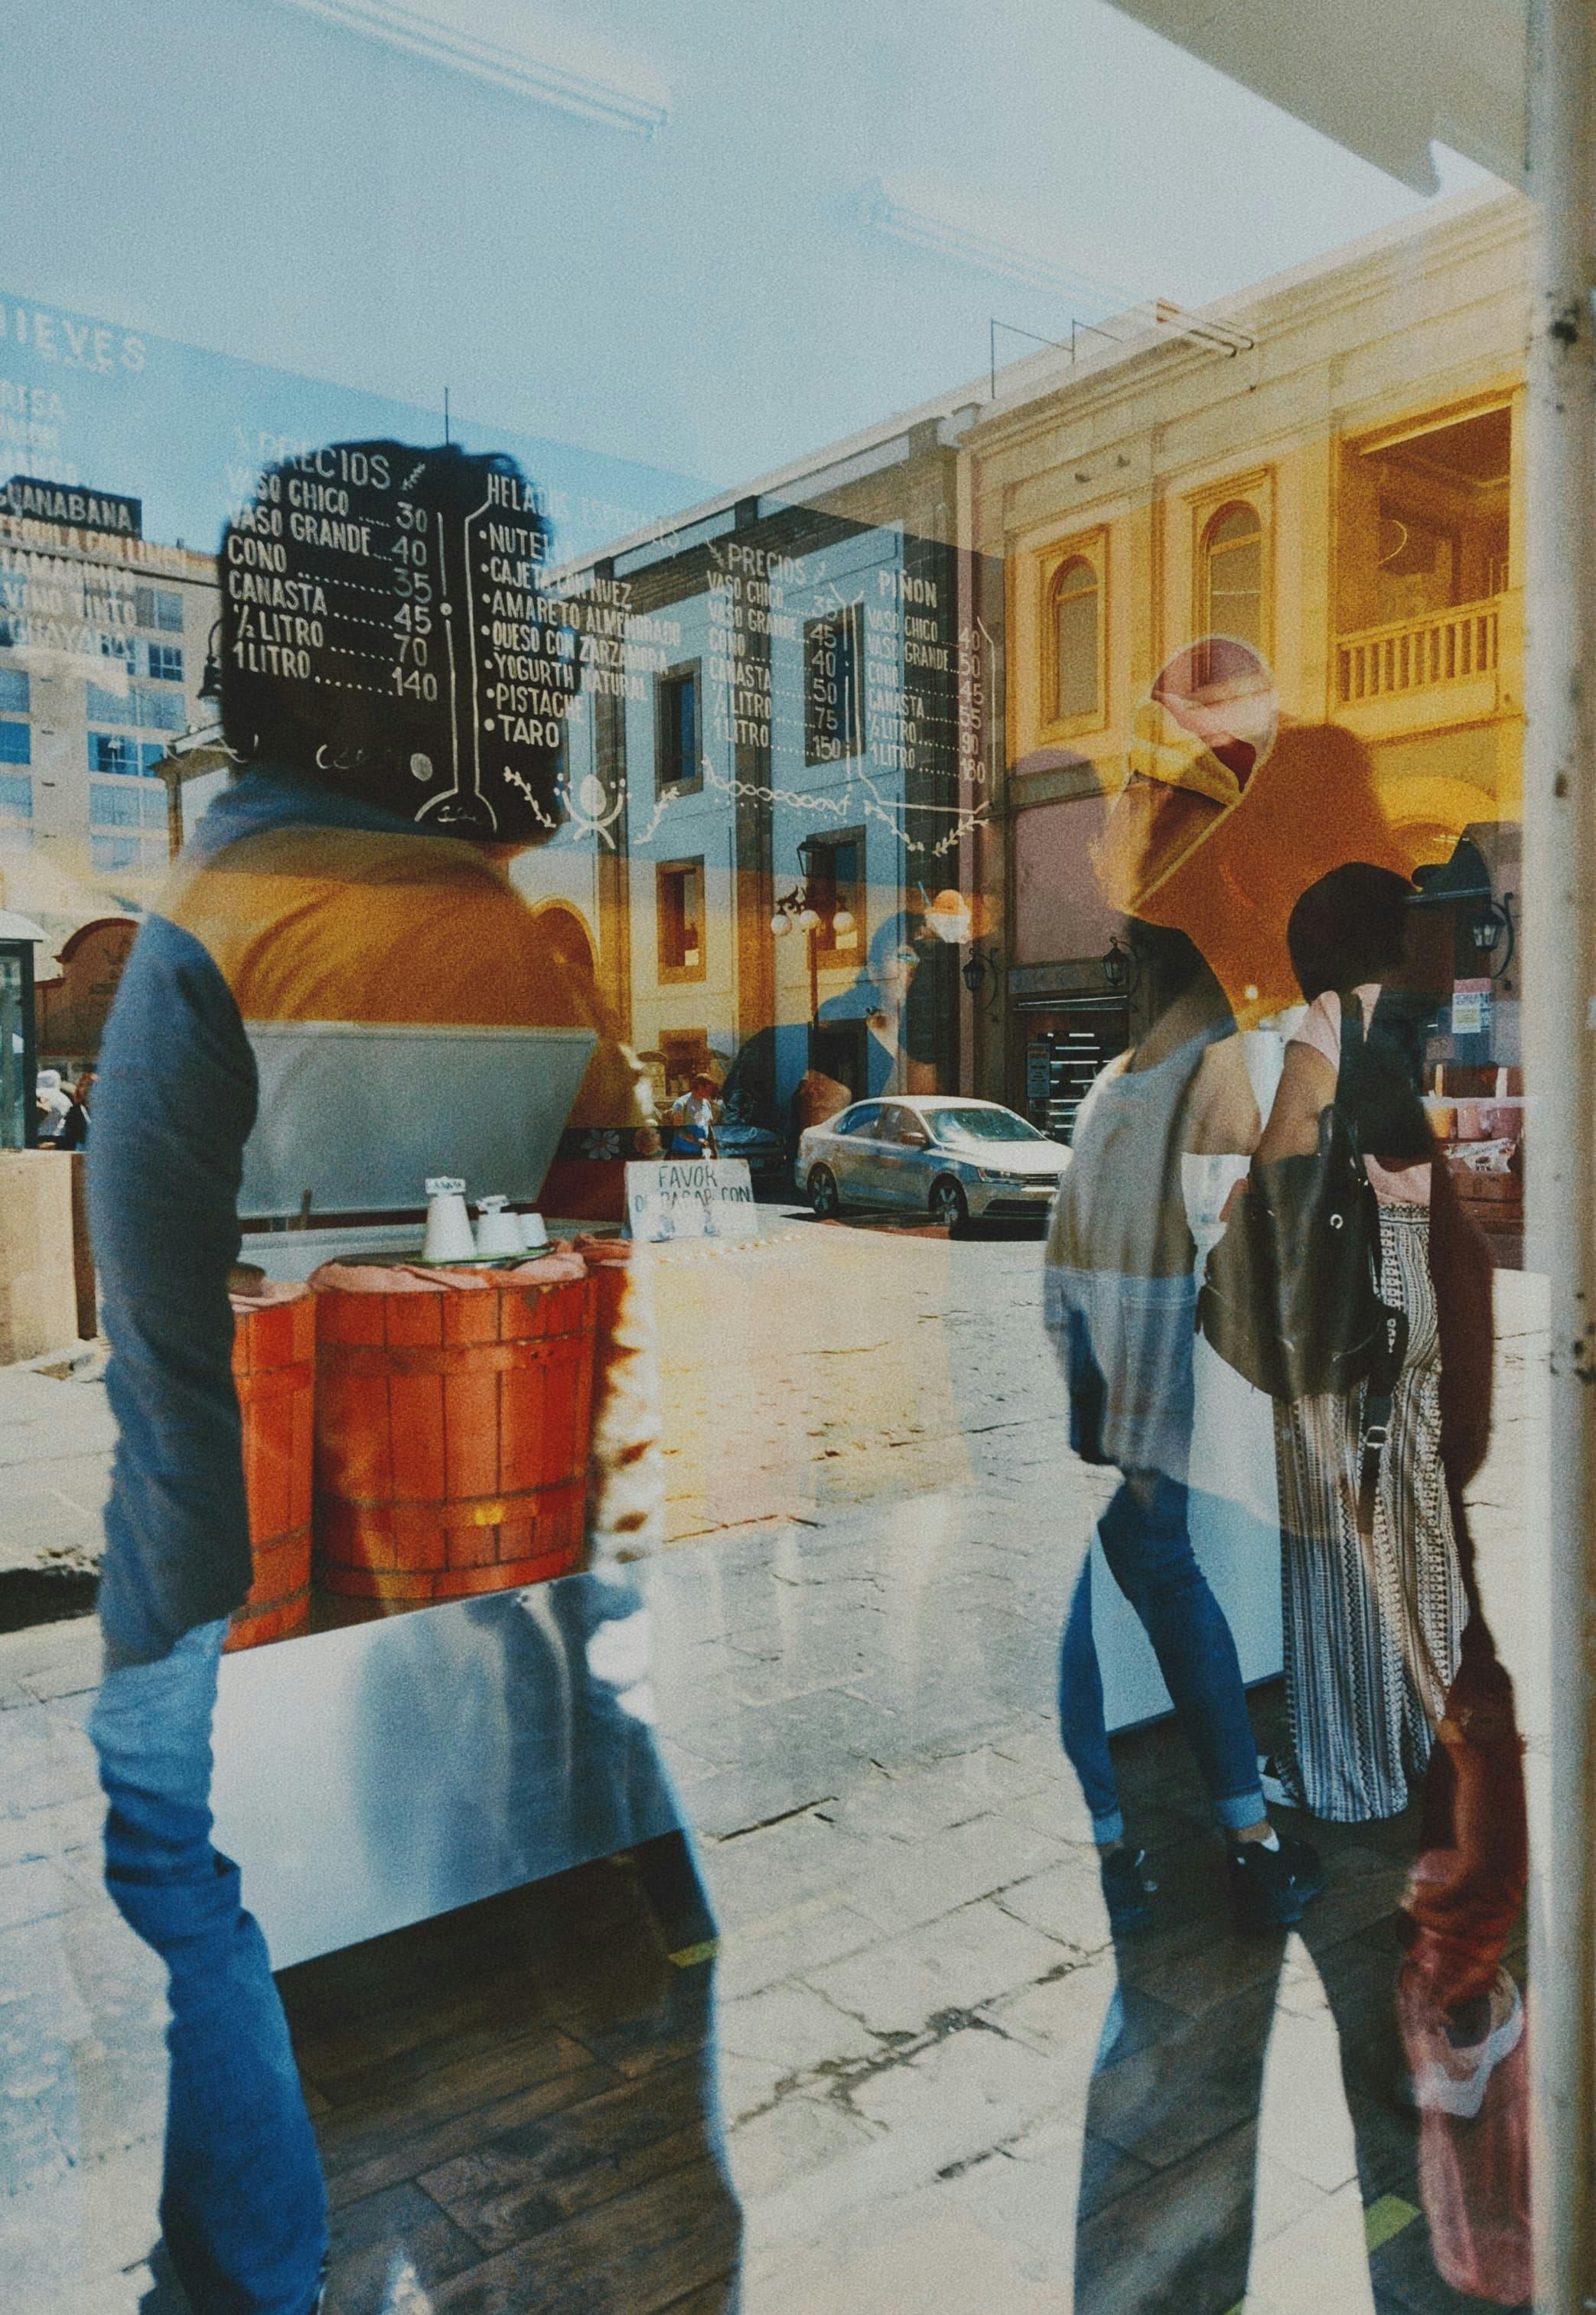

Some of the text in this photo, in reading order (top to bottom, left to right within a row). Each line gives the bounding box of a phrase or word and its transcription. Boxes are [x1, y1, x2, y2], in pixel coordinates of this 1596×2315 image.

[288, 478, 349, 517] CHICO
[396, 501, 428, 533] 30
[228, 499, 427, 566] VASO GRANDE 40
[228, 534, 432, 605] CONO 35
[728, 543, 806, 585] PRECIOS
[229, 569, 432, 634] CANASTA 45
[491, 589, 581, 631] AMARETO
[591, 578, 632, 610] NUEZ
[707, 570, 838, 622] VASO CHICO 35
[259, 610, 324, 648] LITRO
[393, 632, 428, 667] 70
[492, 621, 540, 653] QUESO
[546, 629, 575, 660] CON
[809, 623, 837, 649] 45
[866, 605, 980, 651] VASO CHICO 40
[493, 652, 574, 689] YOGURTH
[709, 656, 838, 705] CANASTA 50
[811, 649, 836, 678] 40
[904, 641, 949, 672] GRANDE
[959, 651, 981, 679] 50
[391, 666, 438, 702] 140
[497, 683, 586, 723] PISTACHE
[959, 680, 985, 706] 45
[729, 688, 772, 720] LITRO
[814, 706, 839, 730] 75
[868, 687, 982, 730] CANASTA 55
[499, 714, 559, 748] TARO
[813, 734, 841, 761] 150
[881, 714, 917, 744] LITRO
[962, 731, 979, 756] 90
[959, 757, 986, 784] 180
[658, 1165, 718, 1188] FAVOR
